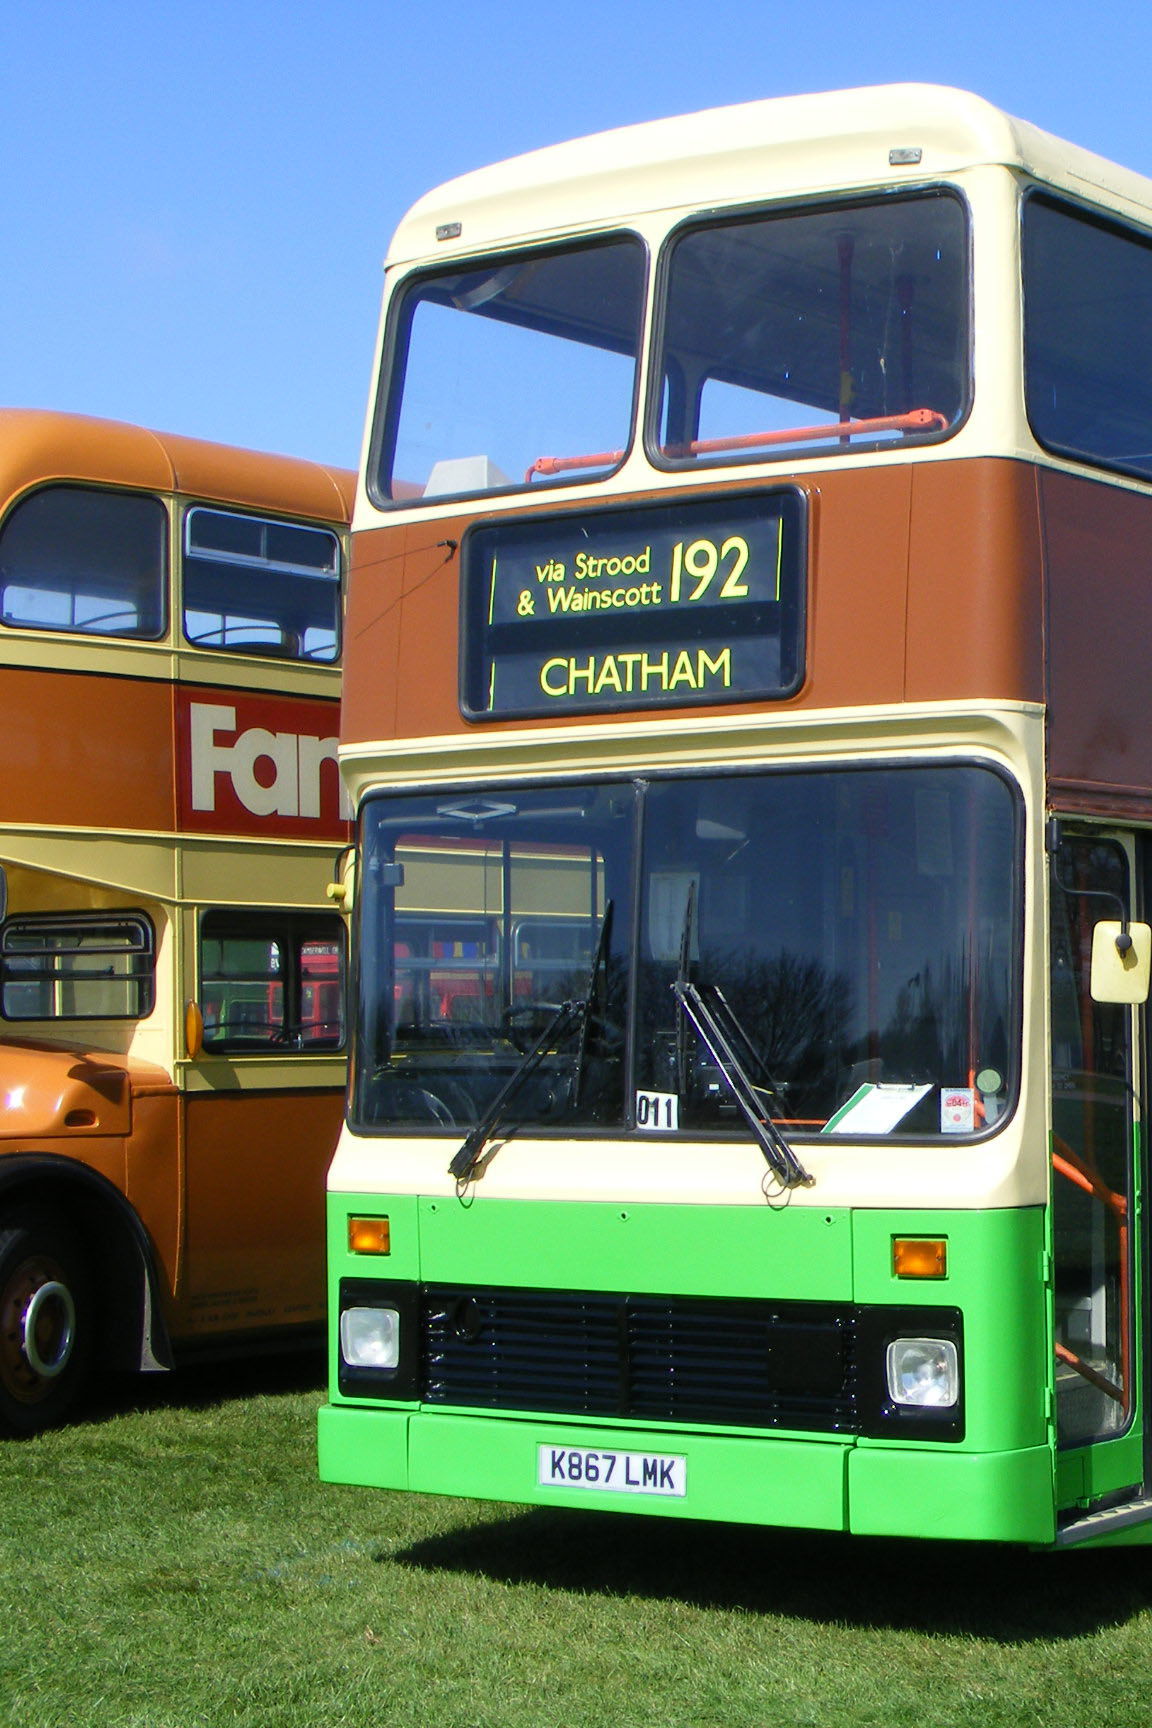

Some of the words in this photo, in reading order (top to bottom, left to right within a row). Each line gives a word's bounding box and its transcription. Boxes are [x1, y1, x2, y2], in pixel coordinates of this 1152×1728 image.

[536, 560, 566, 583] via
[575, 546, 651, 579] Strood
[670, 536, 749, 602] 192
[516, 590, 535, 616] &
[547, 582, 662, 613] Wainscott
[540, 648, 732, 697] CHATHAM
[637, 1095, 672, 1128] 011
[551, 1450, 617, 1483] K867
[625, 1456, 675, 1489] LMK
